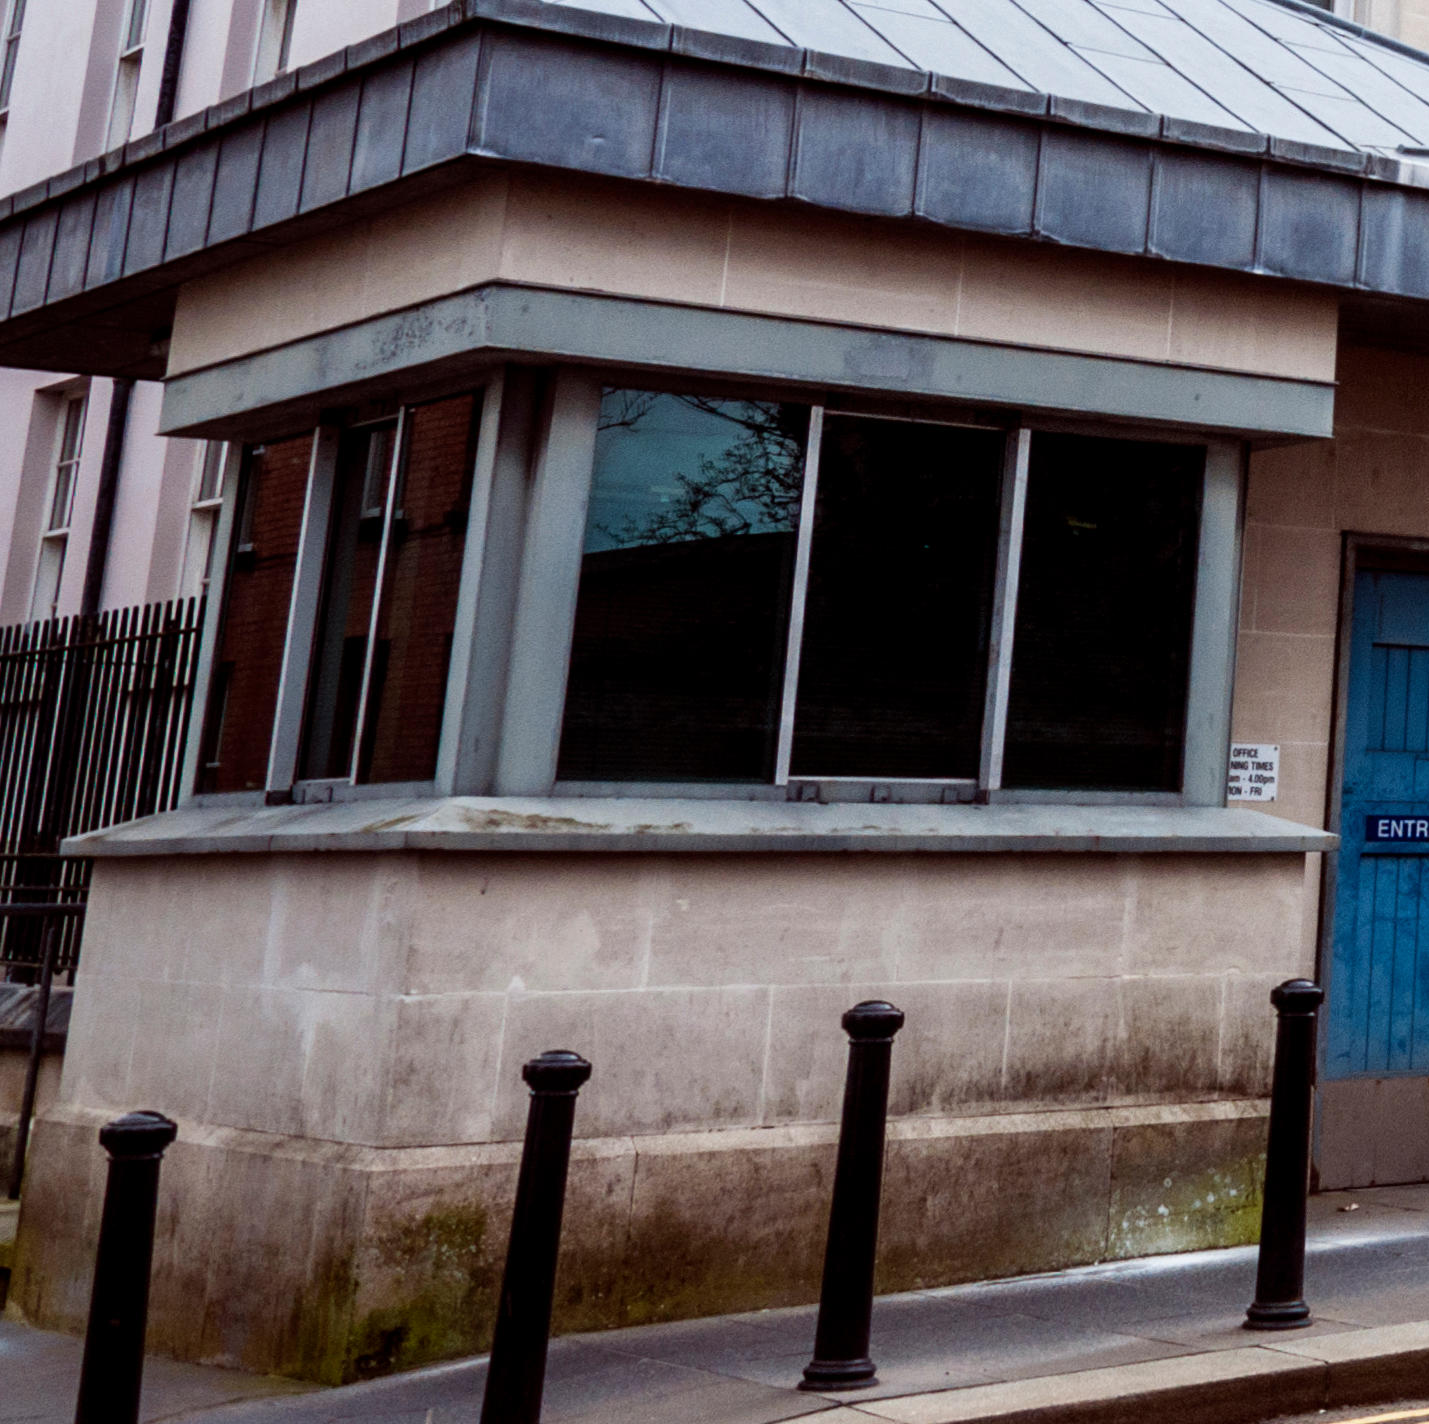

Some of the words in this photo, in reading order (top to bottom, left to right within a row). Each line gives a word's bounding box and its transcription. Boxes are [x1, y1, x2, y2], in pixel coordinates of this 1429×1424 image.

[1232, 747, 1258, 758] OFFICE
[1230, 760, 1249, 770] NING
[1251, 761, 1274, 771] TIMES
[1228, 775, 1240, 783] am
[1248, 774, 1275, 785] 4.00pm
[1250, 786, 1262, 796] FRI
